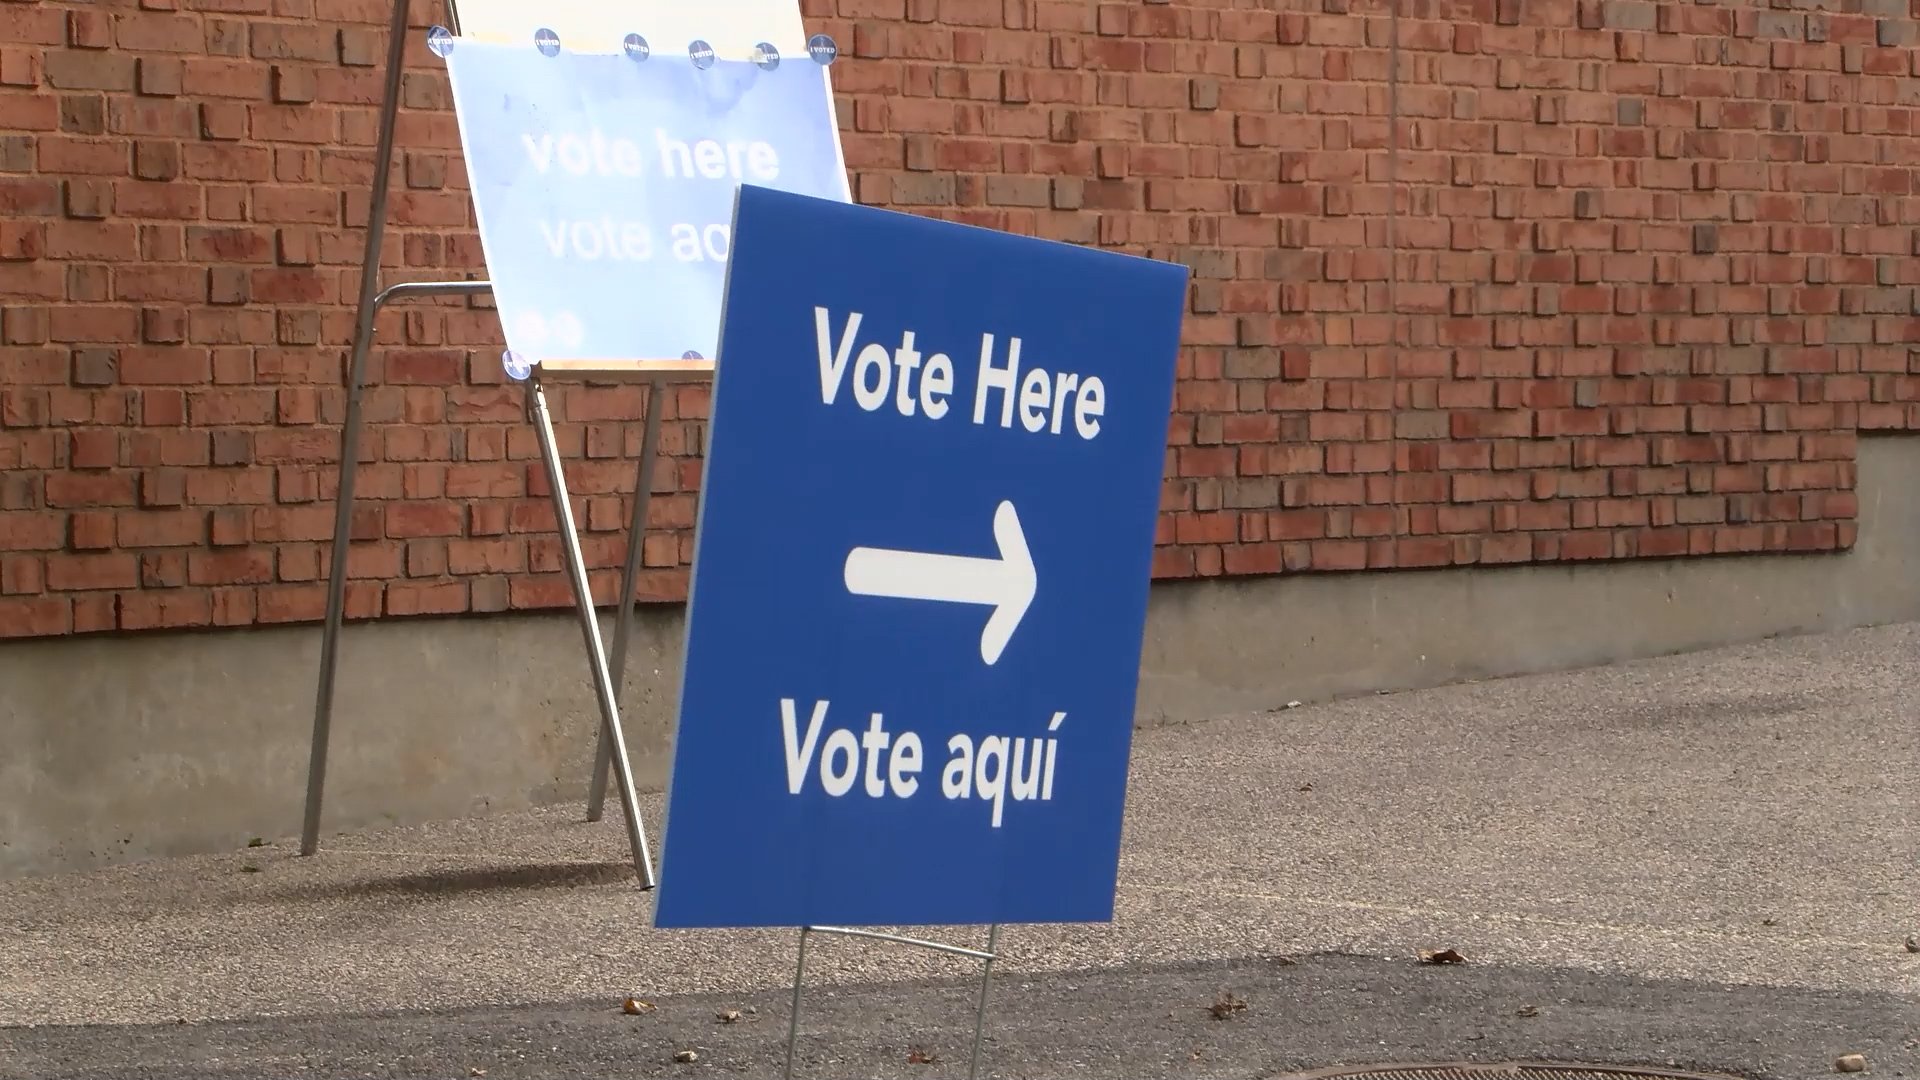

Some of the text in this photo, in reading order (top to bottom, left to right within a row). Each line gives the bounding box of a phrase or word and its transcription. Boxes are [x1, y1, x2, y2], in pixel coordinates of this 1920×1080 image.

[628, 43, 649, 53] VOTED
[695, 50, 713, 58] VOTED
[521, 128, 780, 181] vote here
[540, 213, 652, 261] vote
[814, 306, 1105, 440] Vote Here
[780, 698, 1067, 828] Vote aquí
